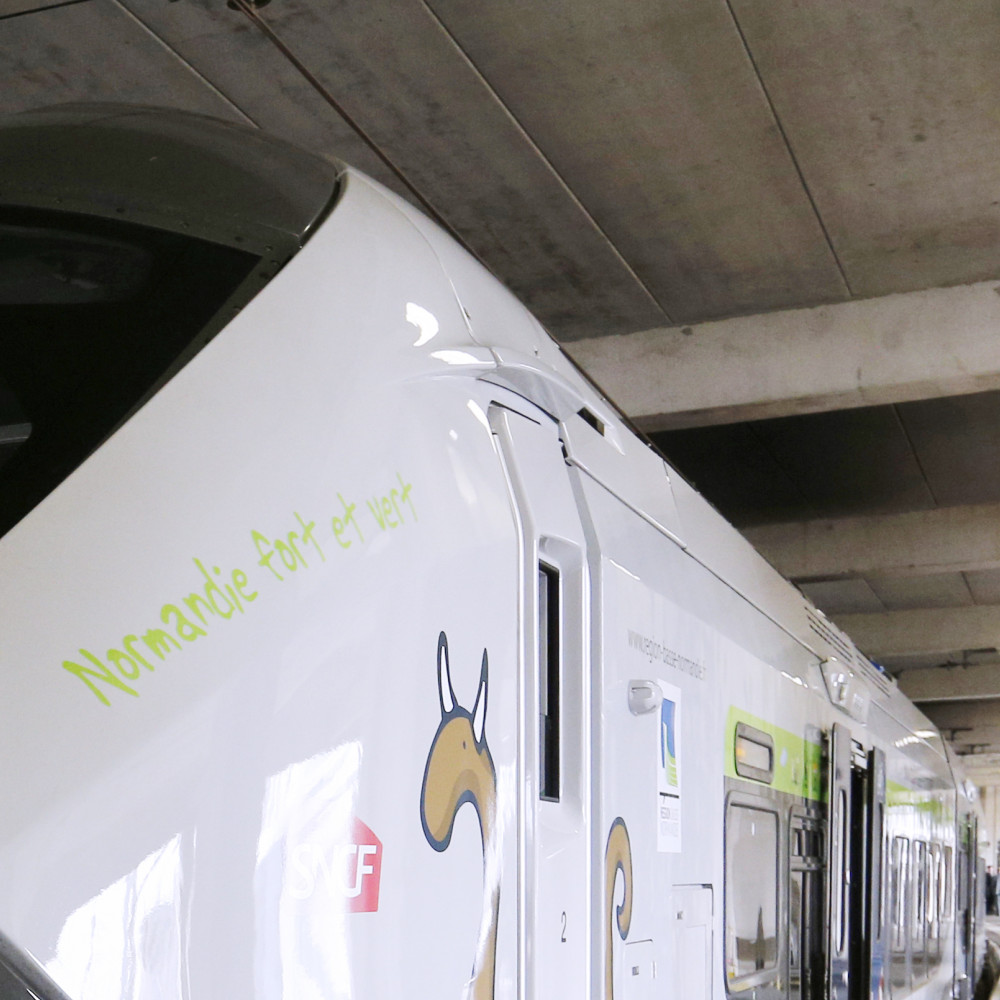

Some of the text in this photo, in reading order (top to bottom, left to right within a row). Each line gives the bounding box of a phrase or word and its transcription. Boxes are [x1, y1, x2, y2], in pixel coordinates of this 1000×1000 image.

[62, 471, 418, 706] Normandie fort et vert
[561, 911, 567, 943] 2
